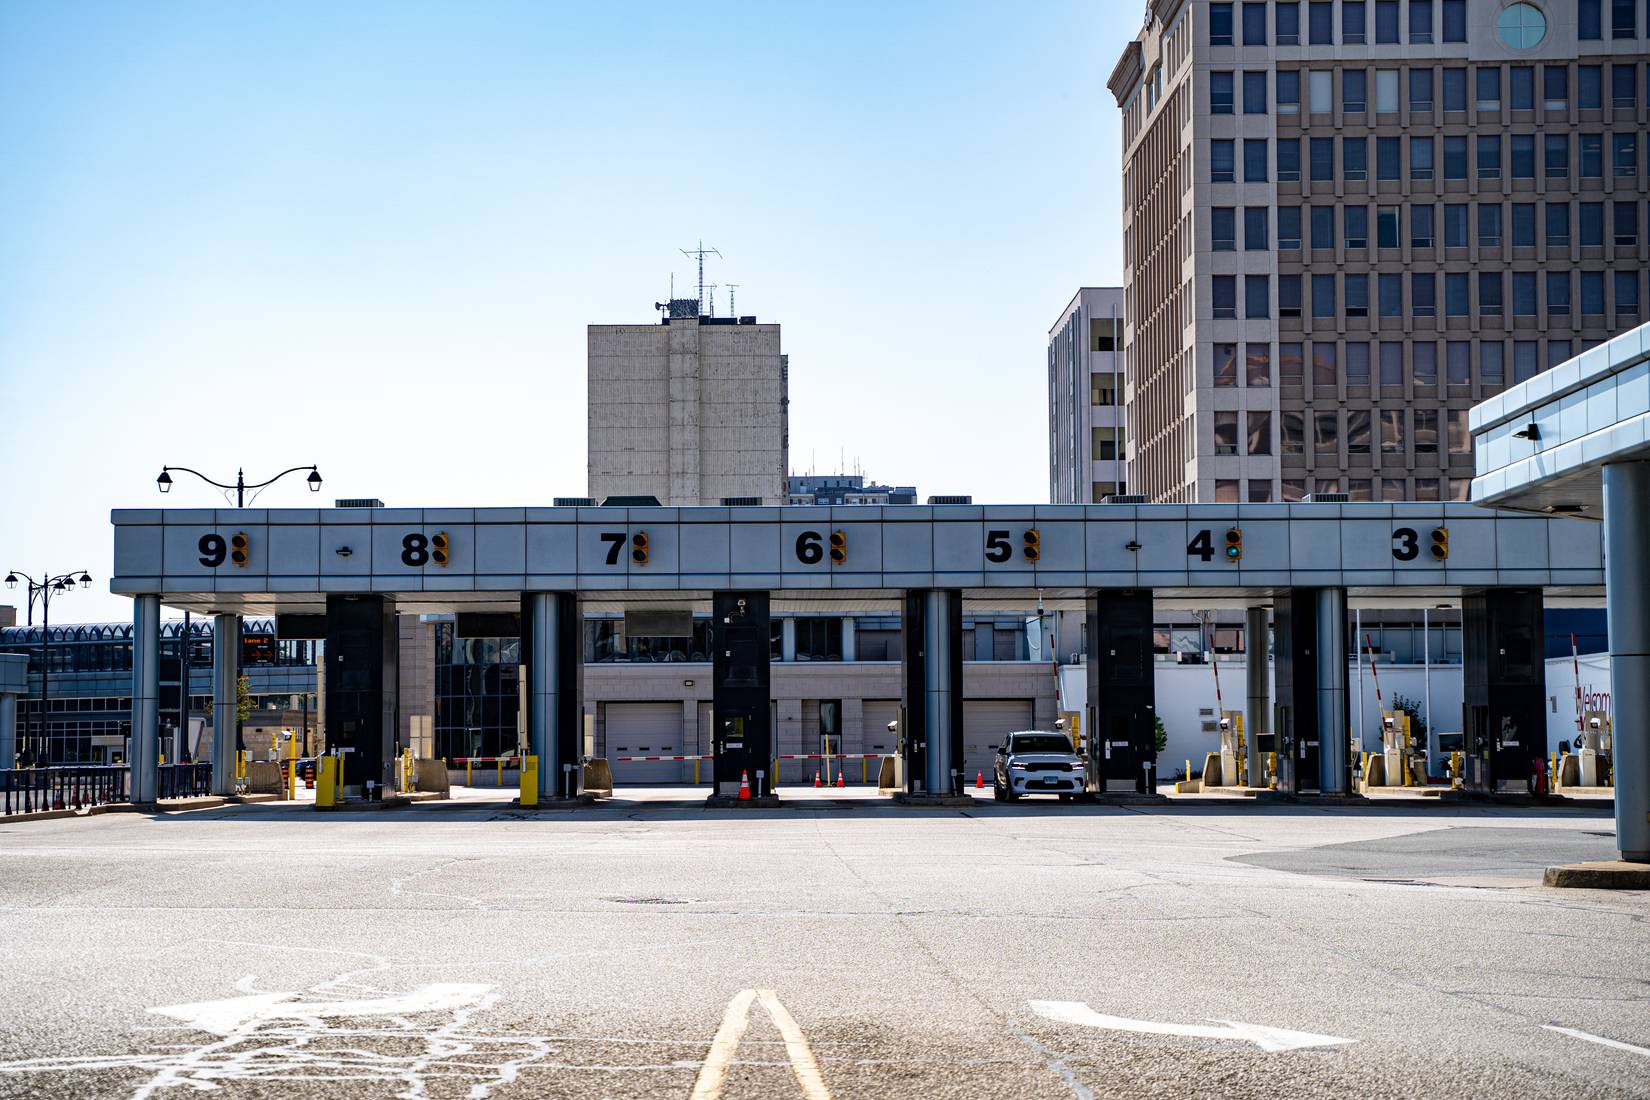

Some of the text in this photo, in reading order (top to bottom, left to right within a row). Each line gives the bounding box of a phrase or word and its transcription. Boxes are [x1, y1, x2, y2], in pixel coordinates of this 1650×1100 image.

[199, 534, 227, 567] 9
[402, 533, 430, 567] 8
[600, 532, 627, 565] 7
[795, 531, 823, 565] 6
[985, 530, 1013, 563] 5
[1187, 529, 1215, 562] 4
[1392, 528, 1419, 561] 3
